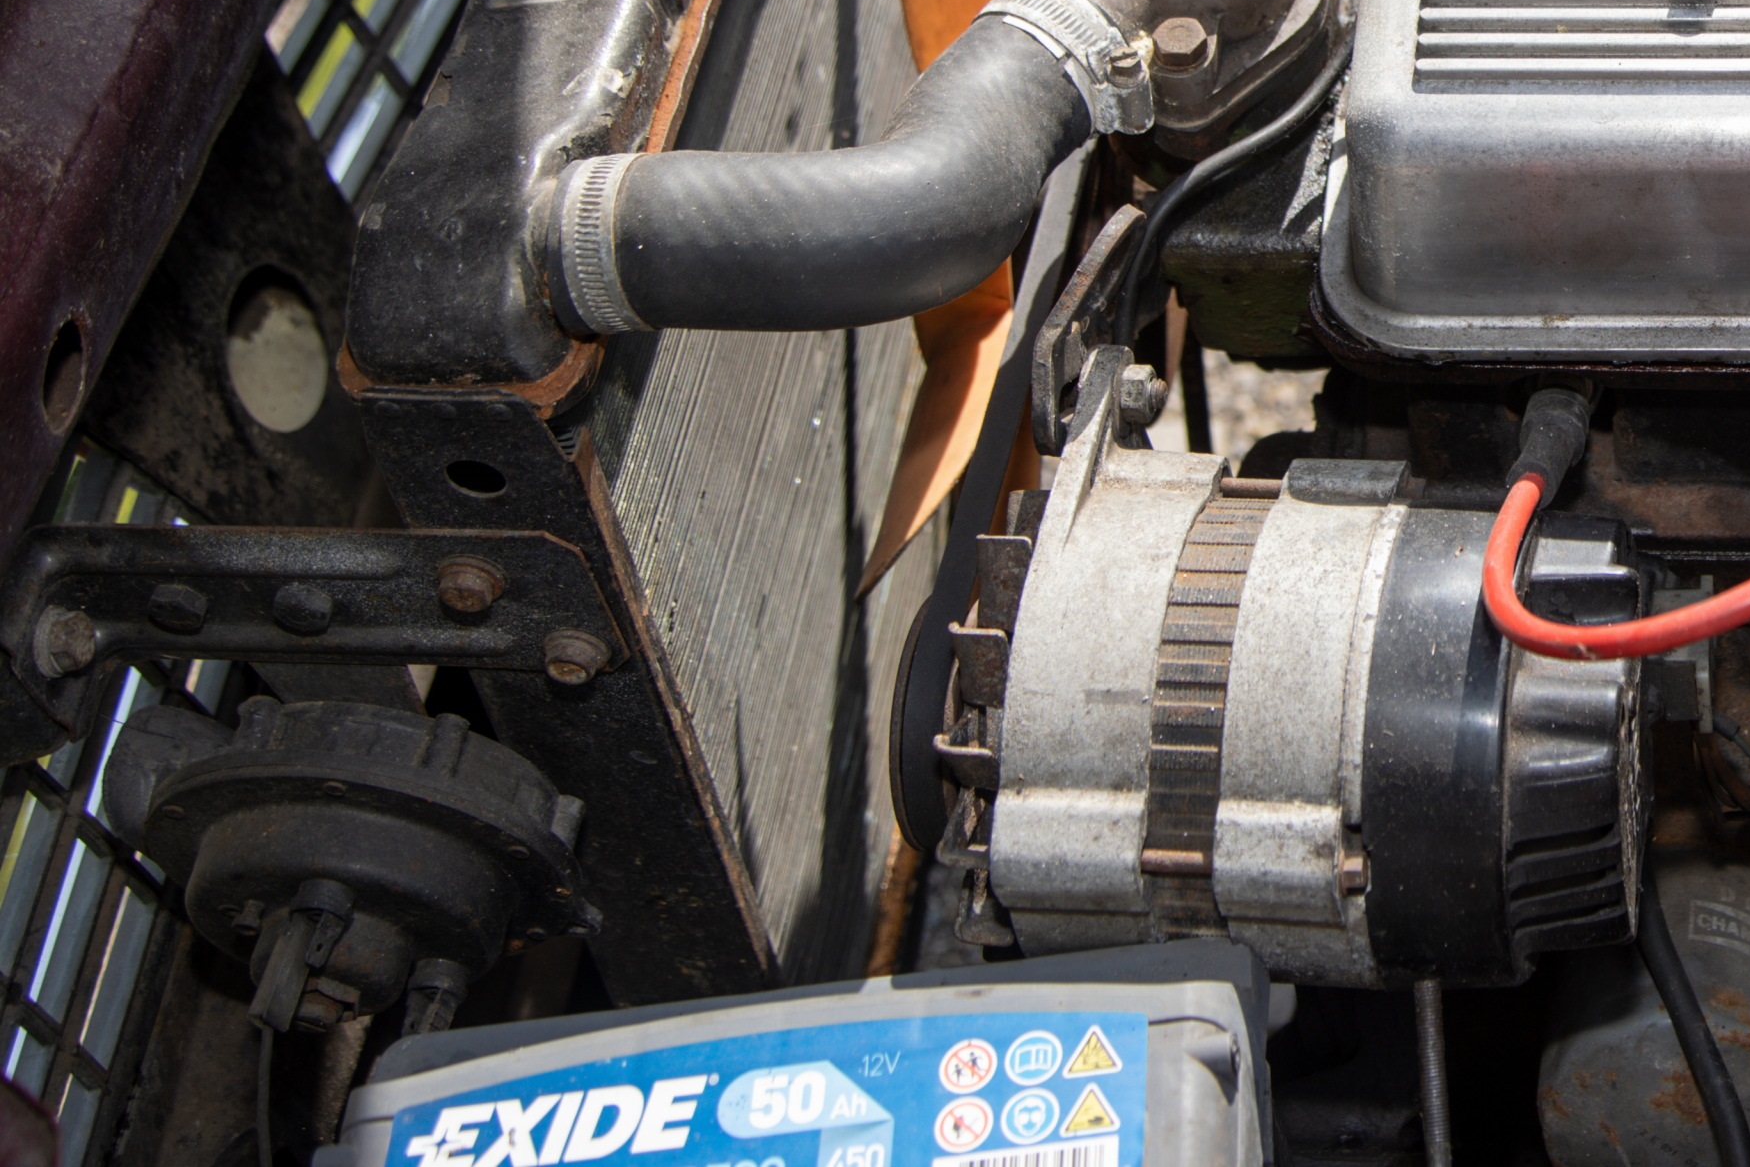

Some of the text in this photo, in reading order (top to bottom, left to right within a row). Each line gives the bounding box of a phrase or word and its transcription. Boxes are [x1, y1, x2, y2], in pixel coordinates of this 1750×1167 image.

[860, 1052, 901, 1077] 12V
[406, 1074, 708, 1167] EXIDE
[748, 1071, 868, 1130] 50 Ah
